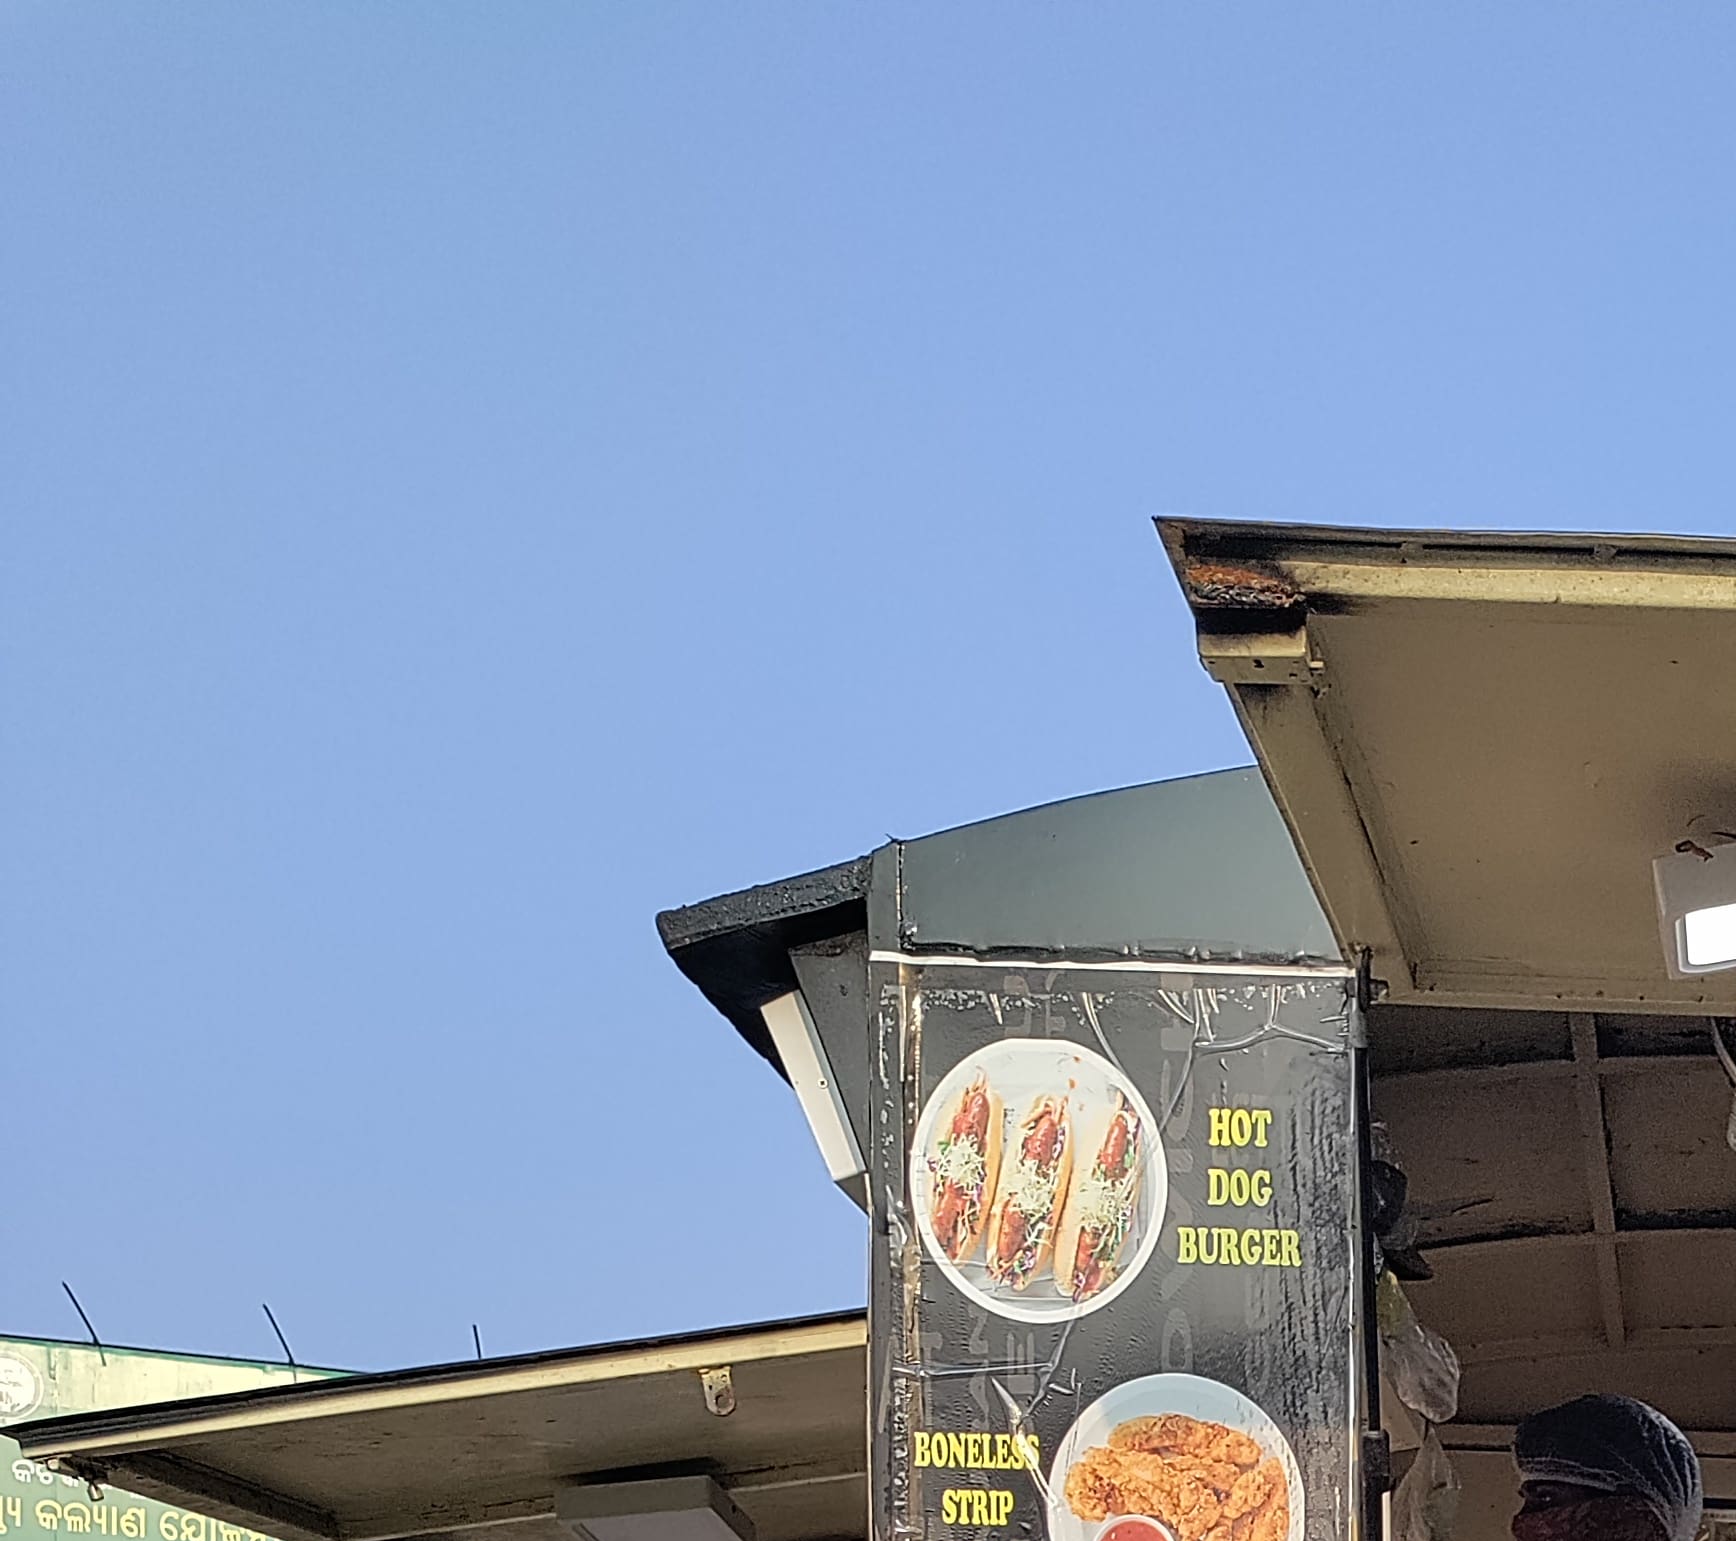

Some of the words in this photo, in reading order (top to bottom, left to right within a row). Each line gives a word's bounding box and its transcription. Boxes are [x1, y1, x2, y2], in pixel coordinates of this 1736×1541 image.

[1207, 1106, 1273, 1149] HOT
[1206, 1166, 1274, 1208] DOG
[1177, 1226, 1303, 1268] BURGER
[913, 1430, 1041, 1470] BONELESS
[35, 1498, 147, 1539] କଲ୍ୟାଣ
[941, 1488, 1015, 1528] STRIP
